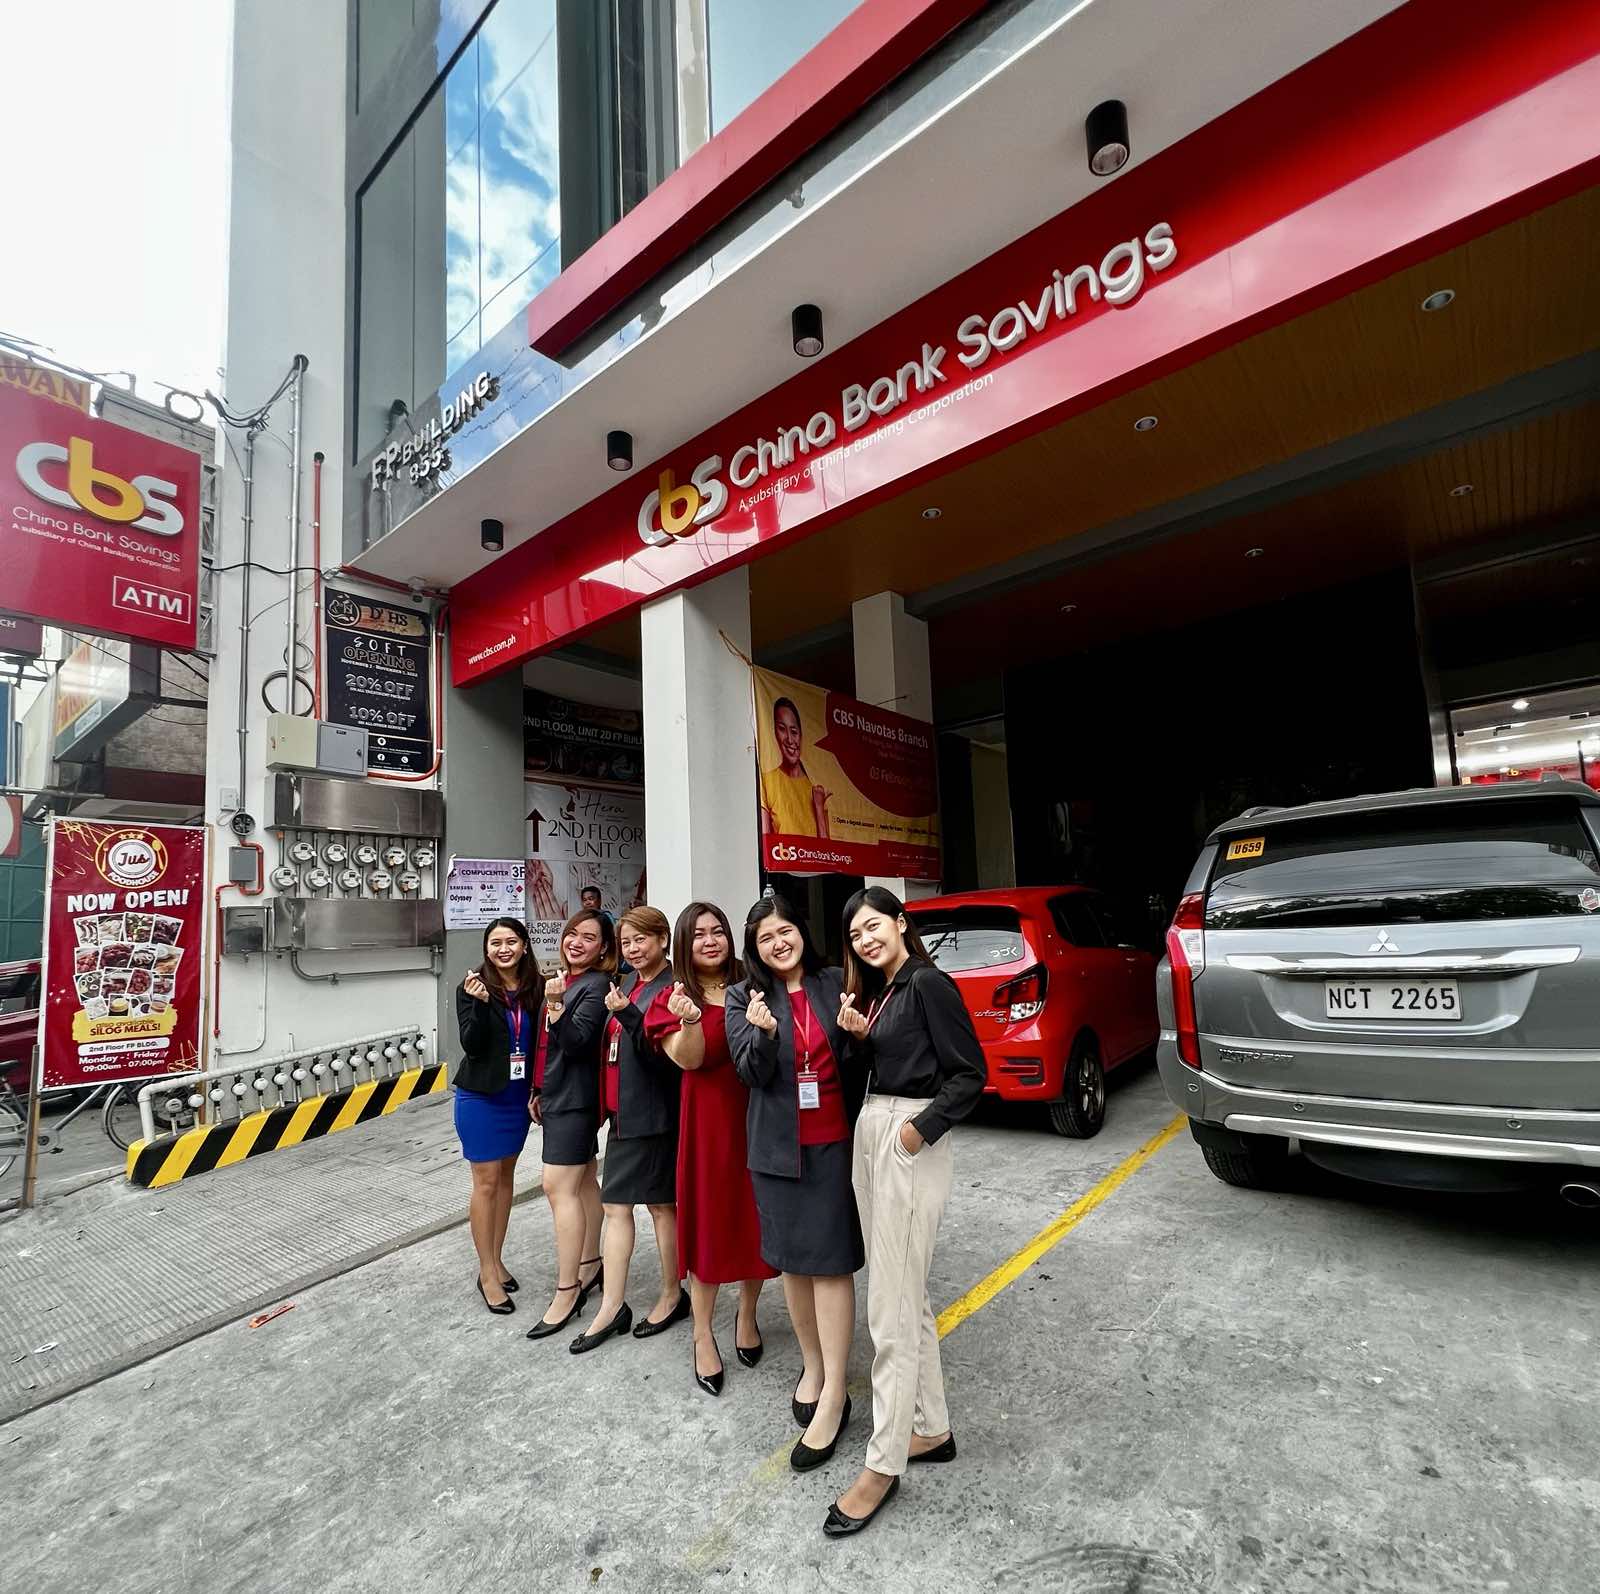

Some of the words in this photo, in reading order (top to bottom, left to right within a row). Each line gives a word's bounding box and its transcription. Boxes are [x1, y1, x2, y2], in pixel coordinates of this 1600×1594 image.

[730, 411, 836, 488] China
[842, 342, 947, 432] Bank
[956, 222, 1178, 369] Savings
[402, 371, 491, 465] BUILDING
[738, 499, 747, 512] A
[748, 472, 800, 507] subsidiary
[803, 461, 815, 478] of
[854, 419, 904, 453] Banking
[908, 372, 994, 424] Corporation
[12, 506, 69, 532] China
[73, 522, 115, 545] Bank
[119, 535, 181, 563] Savings
[20, 525, 66, 543] subsidiary
[78, 540, 102, 552] China
[103, 546, 136, 562] Banking
[136, 555, 181, 572] Corporation
[121, 585, 183, 616] ATM
[353, 636, 407, 657] SOFT
[467, 633, 516, 665] www.cbs.com.ph
[344, 645, 416, 672] OPENING
[345, 673, 382, 691] 20%
[384, 680, 415, 696] OFF
[349, 706, 384, 722] 10%
[386, 711, 417, 727] OFF
[833, 708, 855, 728] CBS
[856, 715, 897, 740] Navotas
[898, 728, 929, 749] Branch
[623, 734, 643, 745] BUIL
[547, 819, 584, 839] 2ND
[588, 823, 643, 843] FLOOR
[618, 843, 632, 859] C
[1234, 841, 1262, 855] U659
[117, 852, 151, 867] Jus
[107, 870, 160, 886] FOODHOUSE
[461, 869, 509, 877] COMPUCENTER
[67, 893, 116, 913] NOW
[125, 889, 190, 909] OPEN!
[449, 894, 472, 903] Odyssey
[529, 927, 560, 935] ANICURE
[536, 921, 562, 929] POLISH
[542, 936, 558, 945] only
[1328, 987, 1371, 1011] NCT
[1391, 986, 1456, 1011] 2265
[124, 1023, 161, 1034] MEALS!
[79, 1054, 118, 1065] Monday
[82, 1063, 122, 1073] 09:00am
[128, 1059, 165, 1068] 07:00pm
